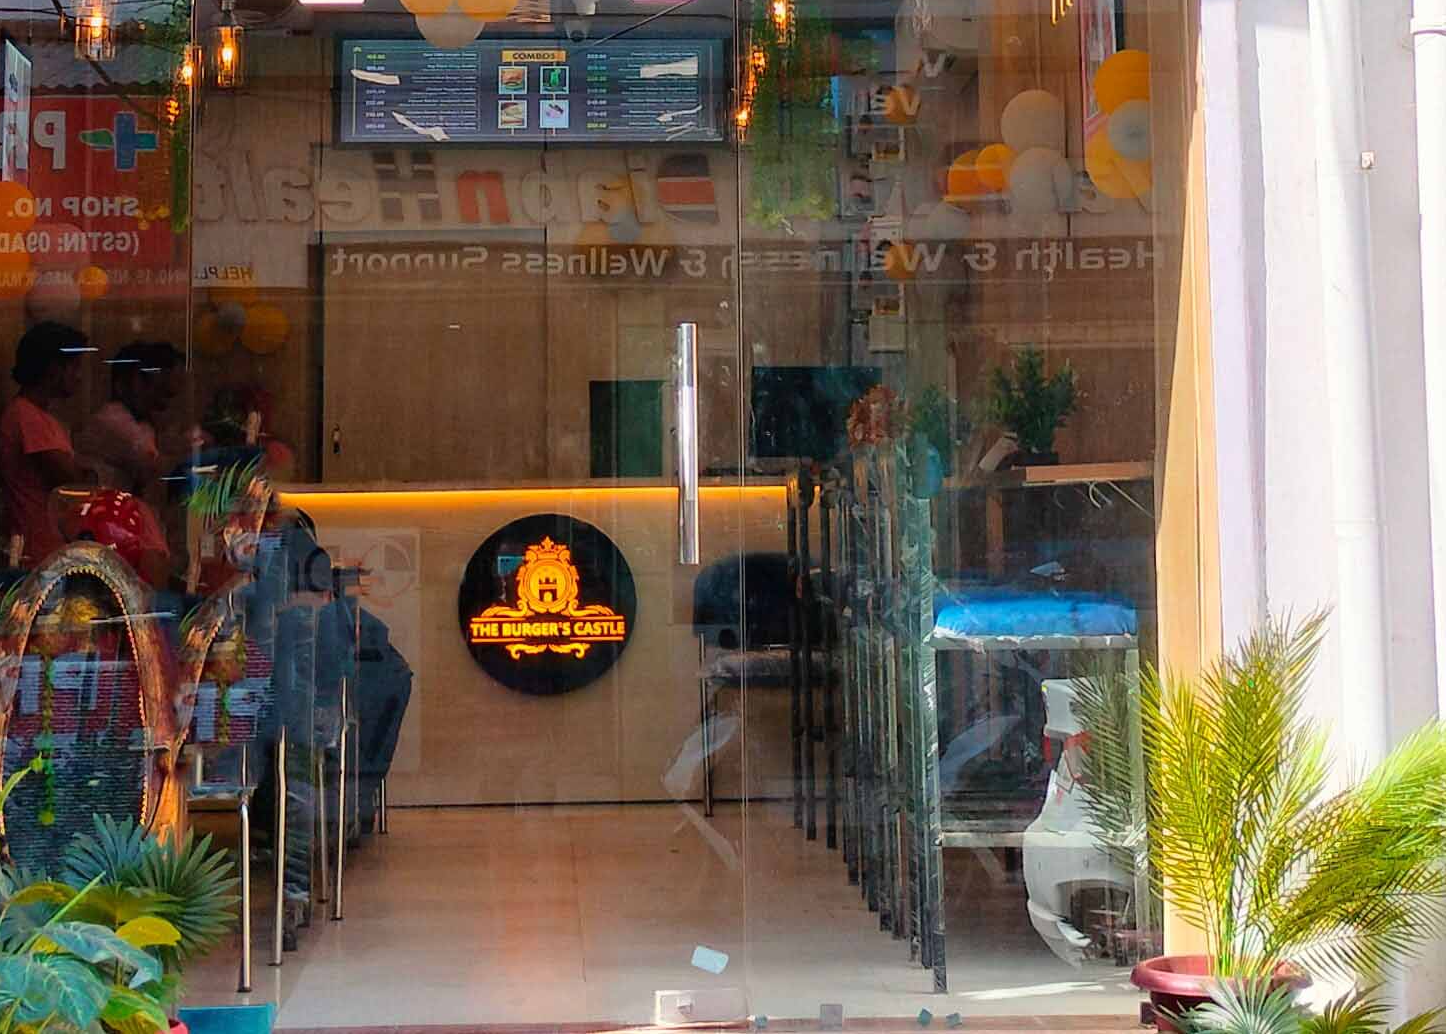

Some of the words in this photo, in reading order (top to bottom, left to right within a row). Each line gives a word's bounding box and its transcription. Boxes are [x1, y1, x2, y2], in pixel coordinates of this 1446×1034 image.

[511, 52, 555, 60] COMBOS
[469, 622, 499, 637] THE
[502, 621, 572, 637] BURGER'S
[573, 620, 626, 635] CASTLE
